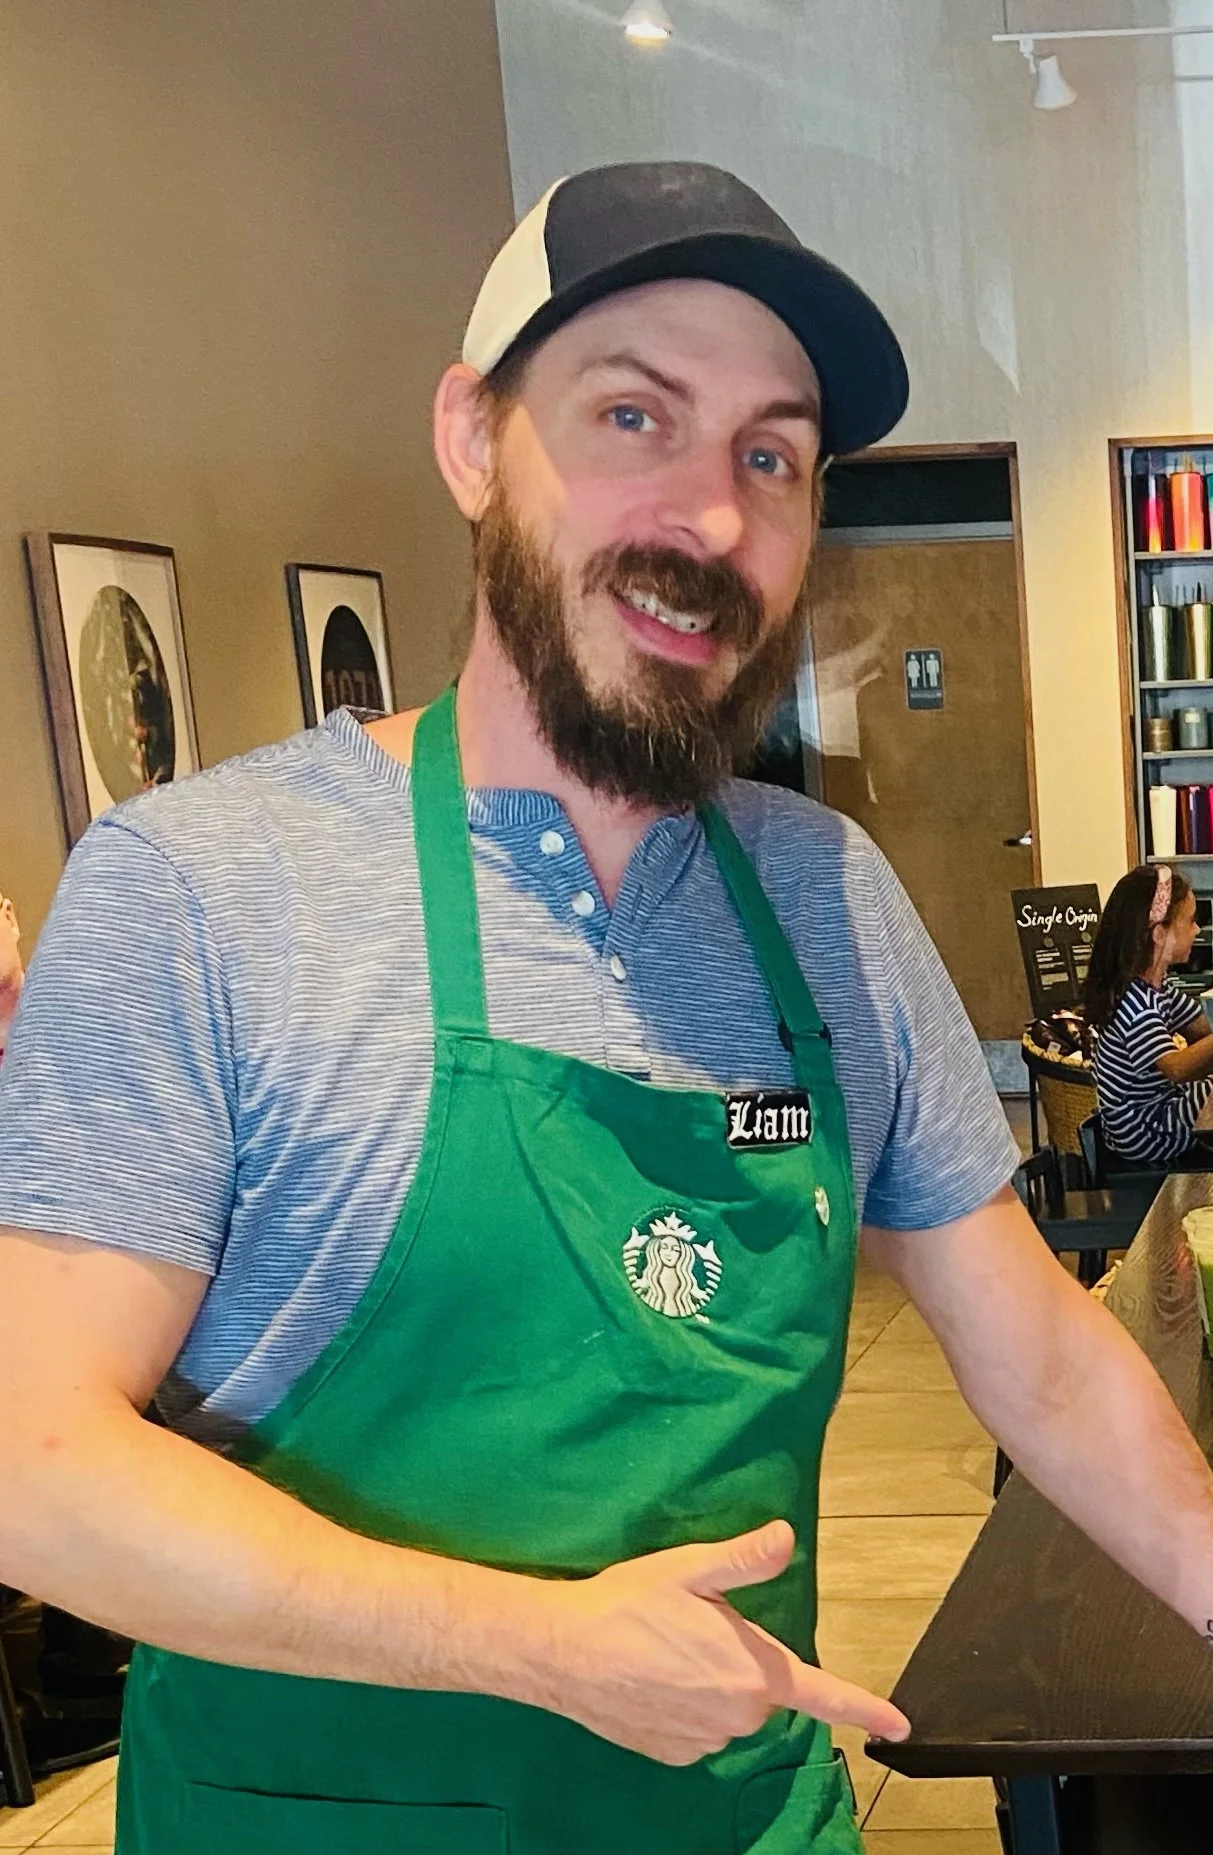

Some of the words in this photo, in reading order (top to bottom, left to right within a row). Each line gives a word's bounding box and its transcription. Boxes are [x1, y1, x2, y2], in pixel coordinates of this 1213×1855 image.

[1017, 904, 1062, 933] Single
[1065, 905, 1099, 931] Origin
[728, 1092, 810, 1141] Liam
